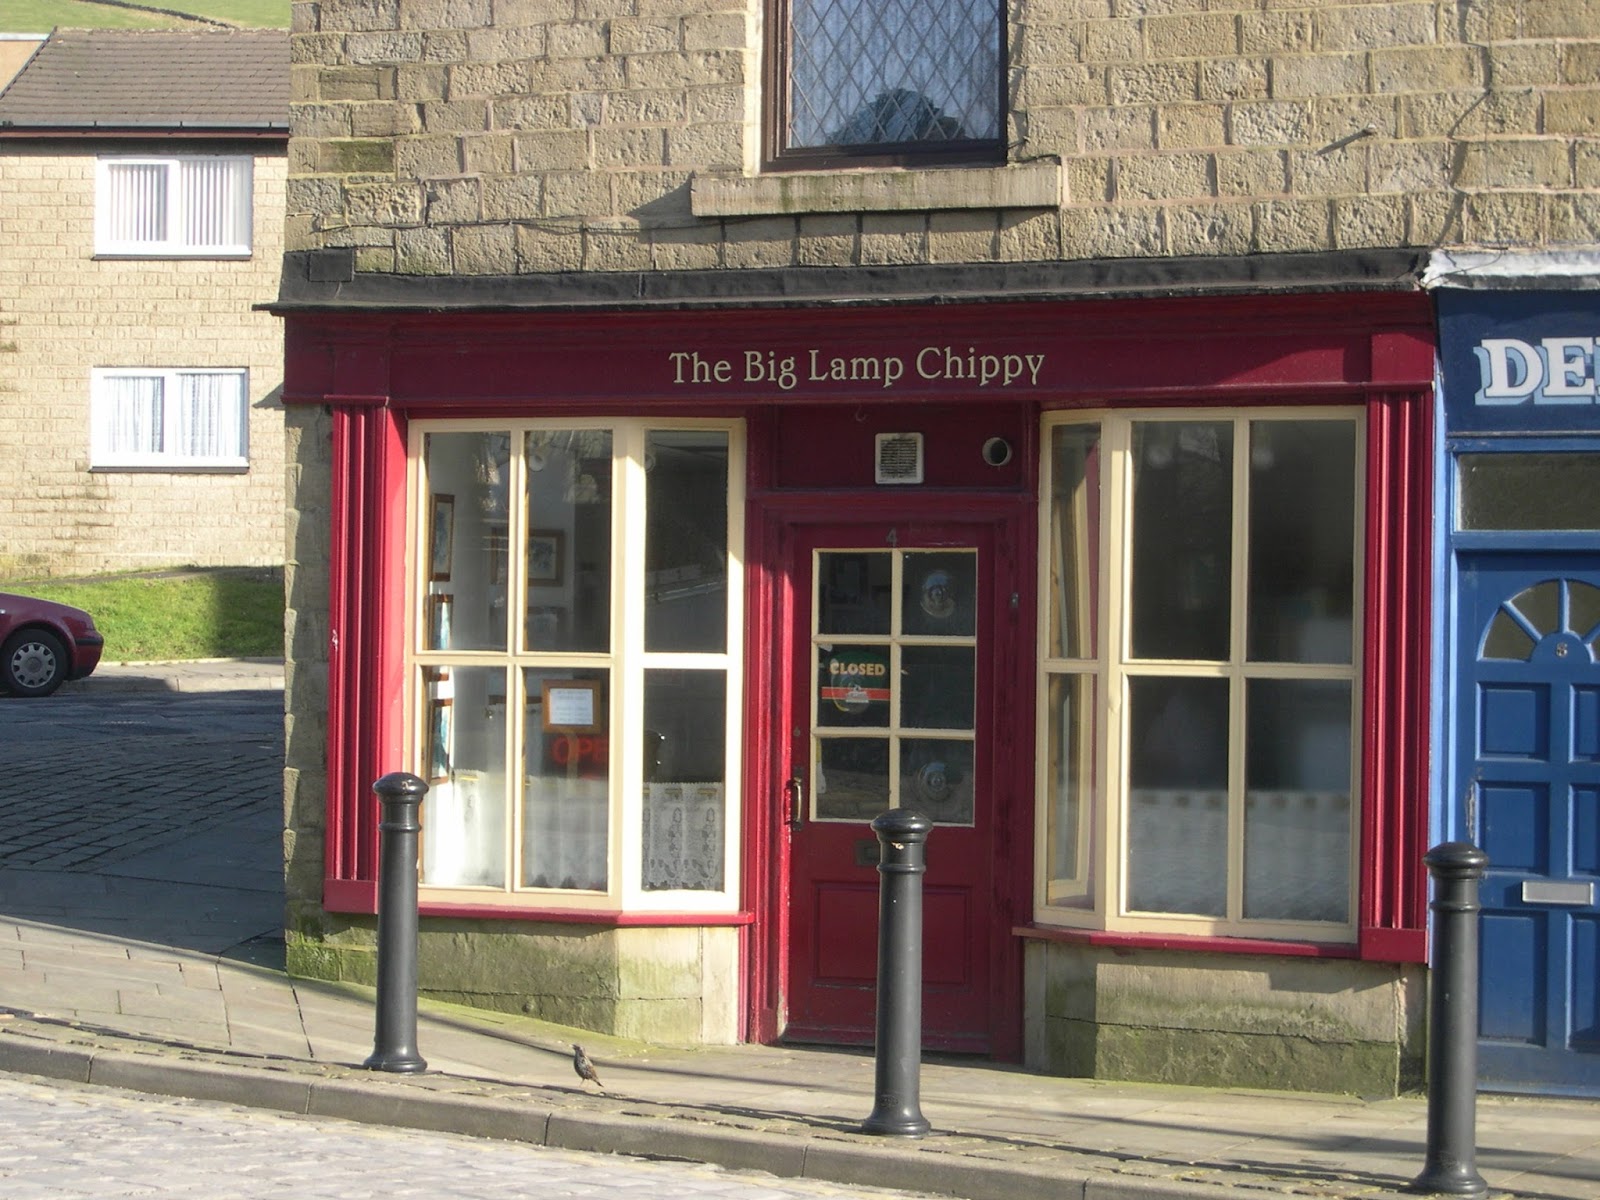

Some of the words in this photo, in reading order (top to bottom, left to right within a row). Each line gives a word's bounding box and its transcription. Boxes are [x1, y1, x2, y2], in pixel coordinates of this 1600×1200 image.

[669, 351, 732, 384] The
[743, 350, 797, 390] Big
[808, 349, 904, 388] Lamp
[916, 346, 1045, 386] Chippy
[1473, 337, 1600, 405] DE
[886, 527, 897, 548] 4
[829, 662, 886, 676] CLOSED
[552, 735, 609, 765] OPE
